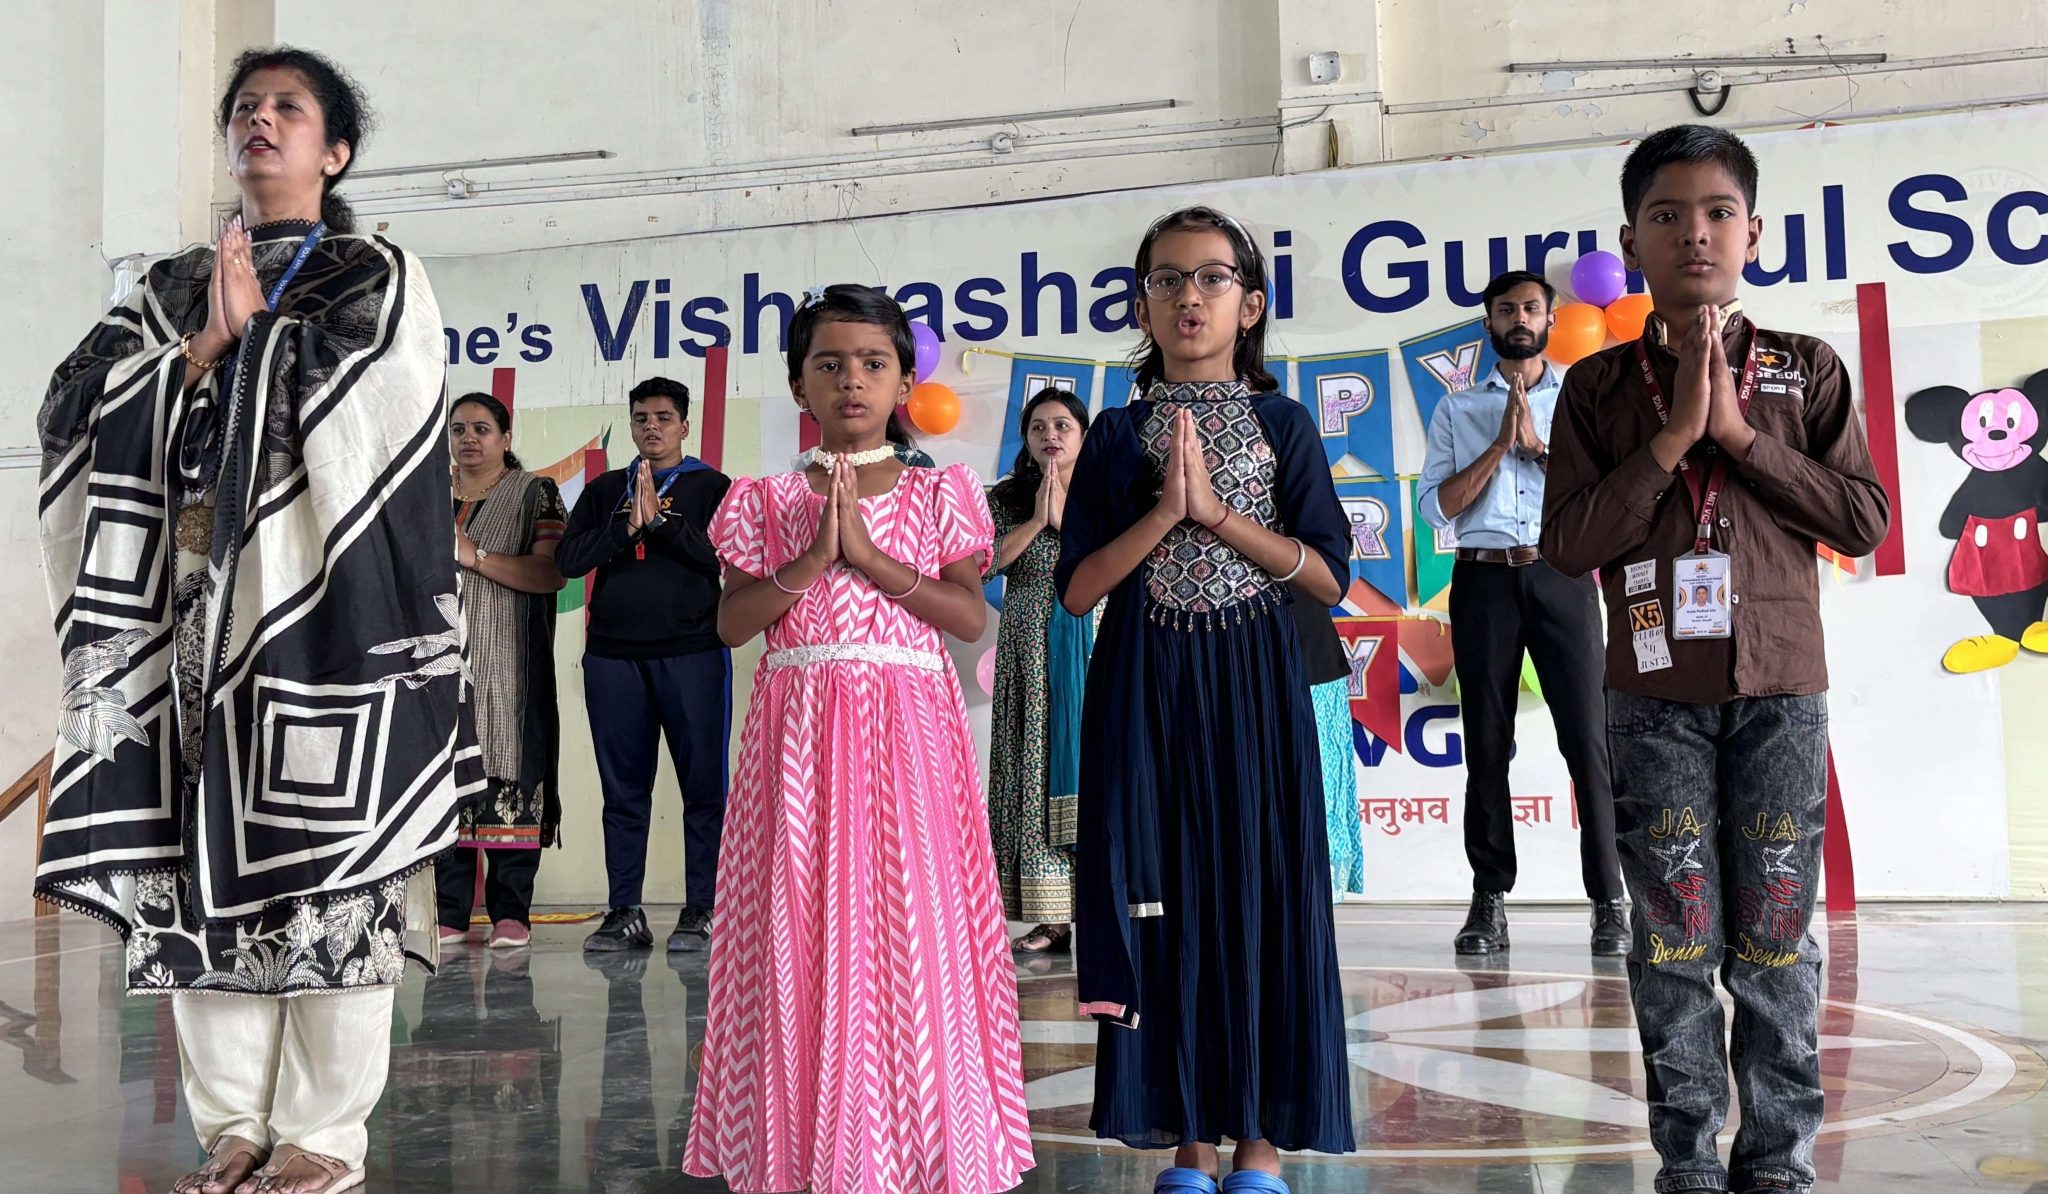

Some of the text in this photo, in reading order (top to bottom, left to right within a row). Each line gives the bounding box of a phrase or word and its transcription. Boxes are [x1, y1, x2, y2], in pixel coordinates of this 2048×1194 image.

[580, 230, 1294, 362] Vishashai
[1631, 603, 1661, 630] X5
[1650, 806, 1702, 839] JA
[1742, 811, 1798, 842] JA
[1648, 932, 1707, 964] Denim
[1739, 931, 1799, 968] Denim
